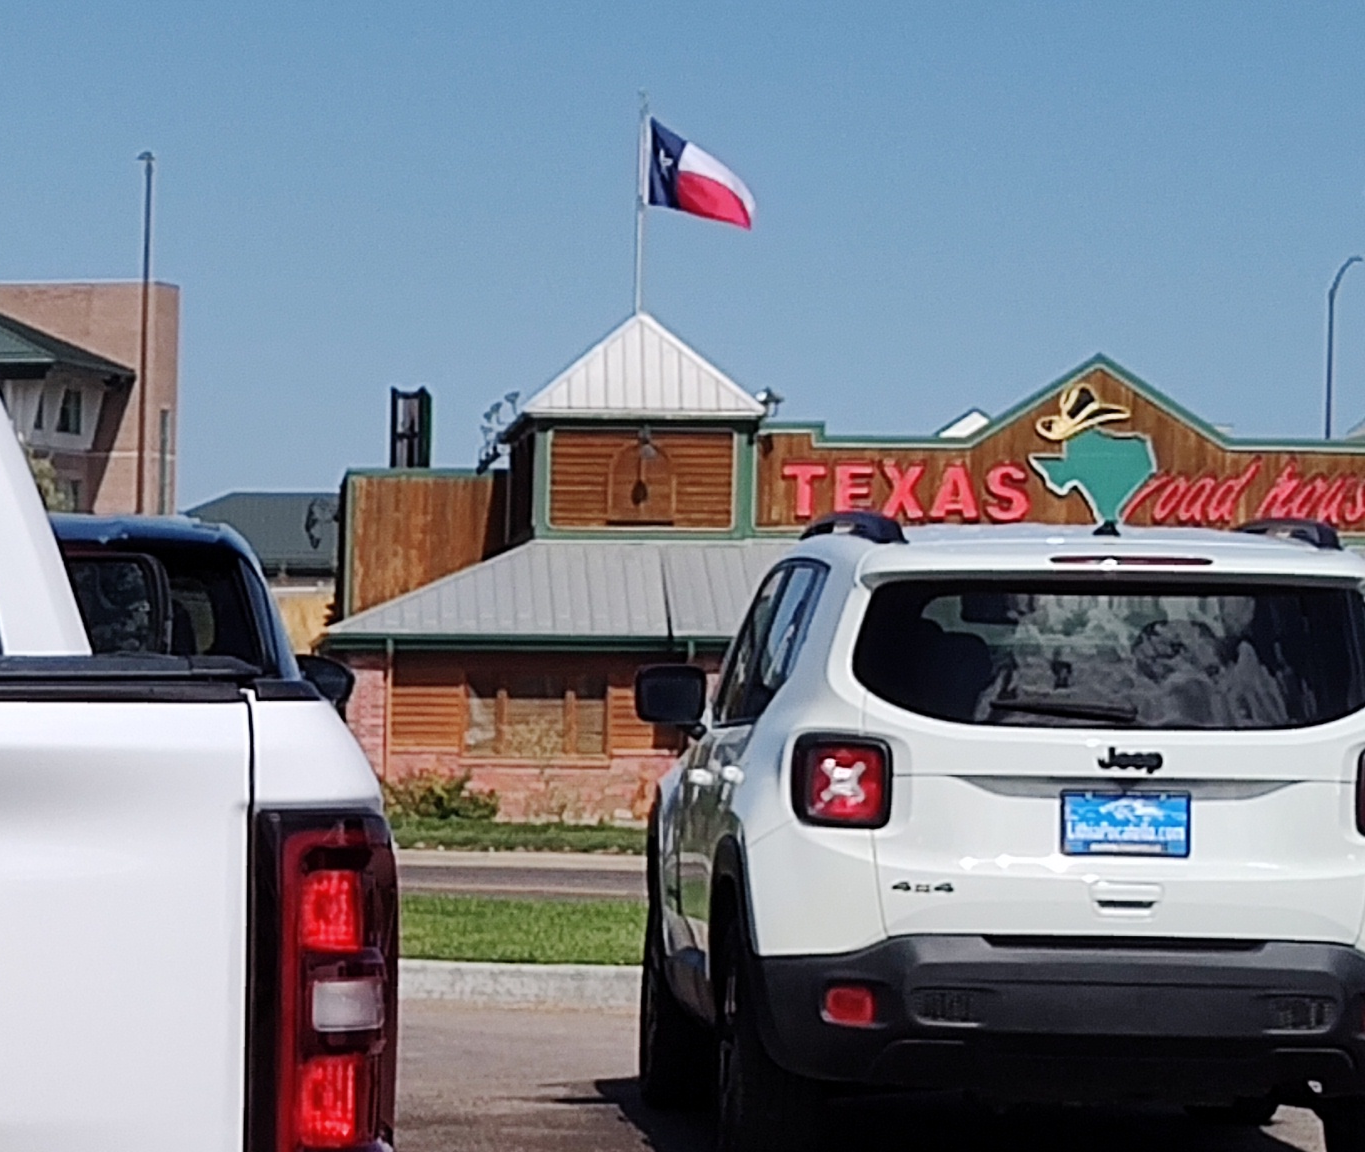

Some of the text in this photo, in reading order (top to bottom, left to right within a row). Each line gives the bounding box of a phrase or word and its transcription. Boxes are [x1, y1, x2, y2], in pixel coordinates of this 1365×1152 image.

[782, 459, 1030, 524] TEXAS
[1121, 456, 1262, 524] road
[1097, 746, 1163, 774] Jeep
